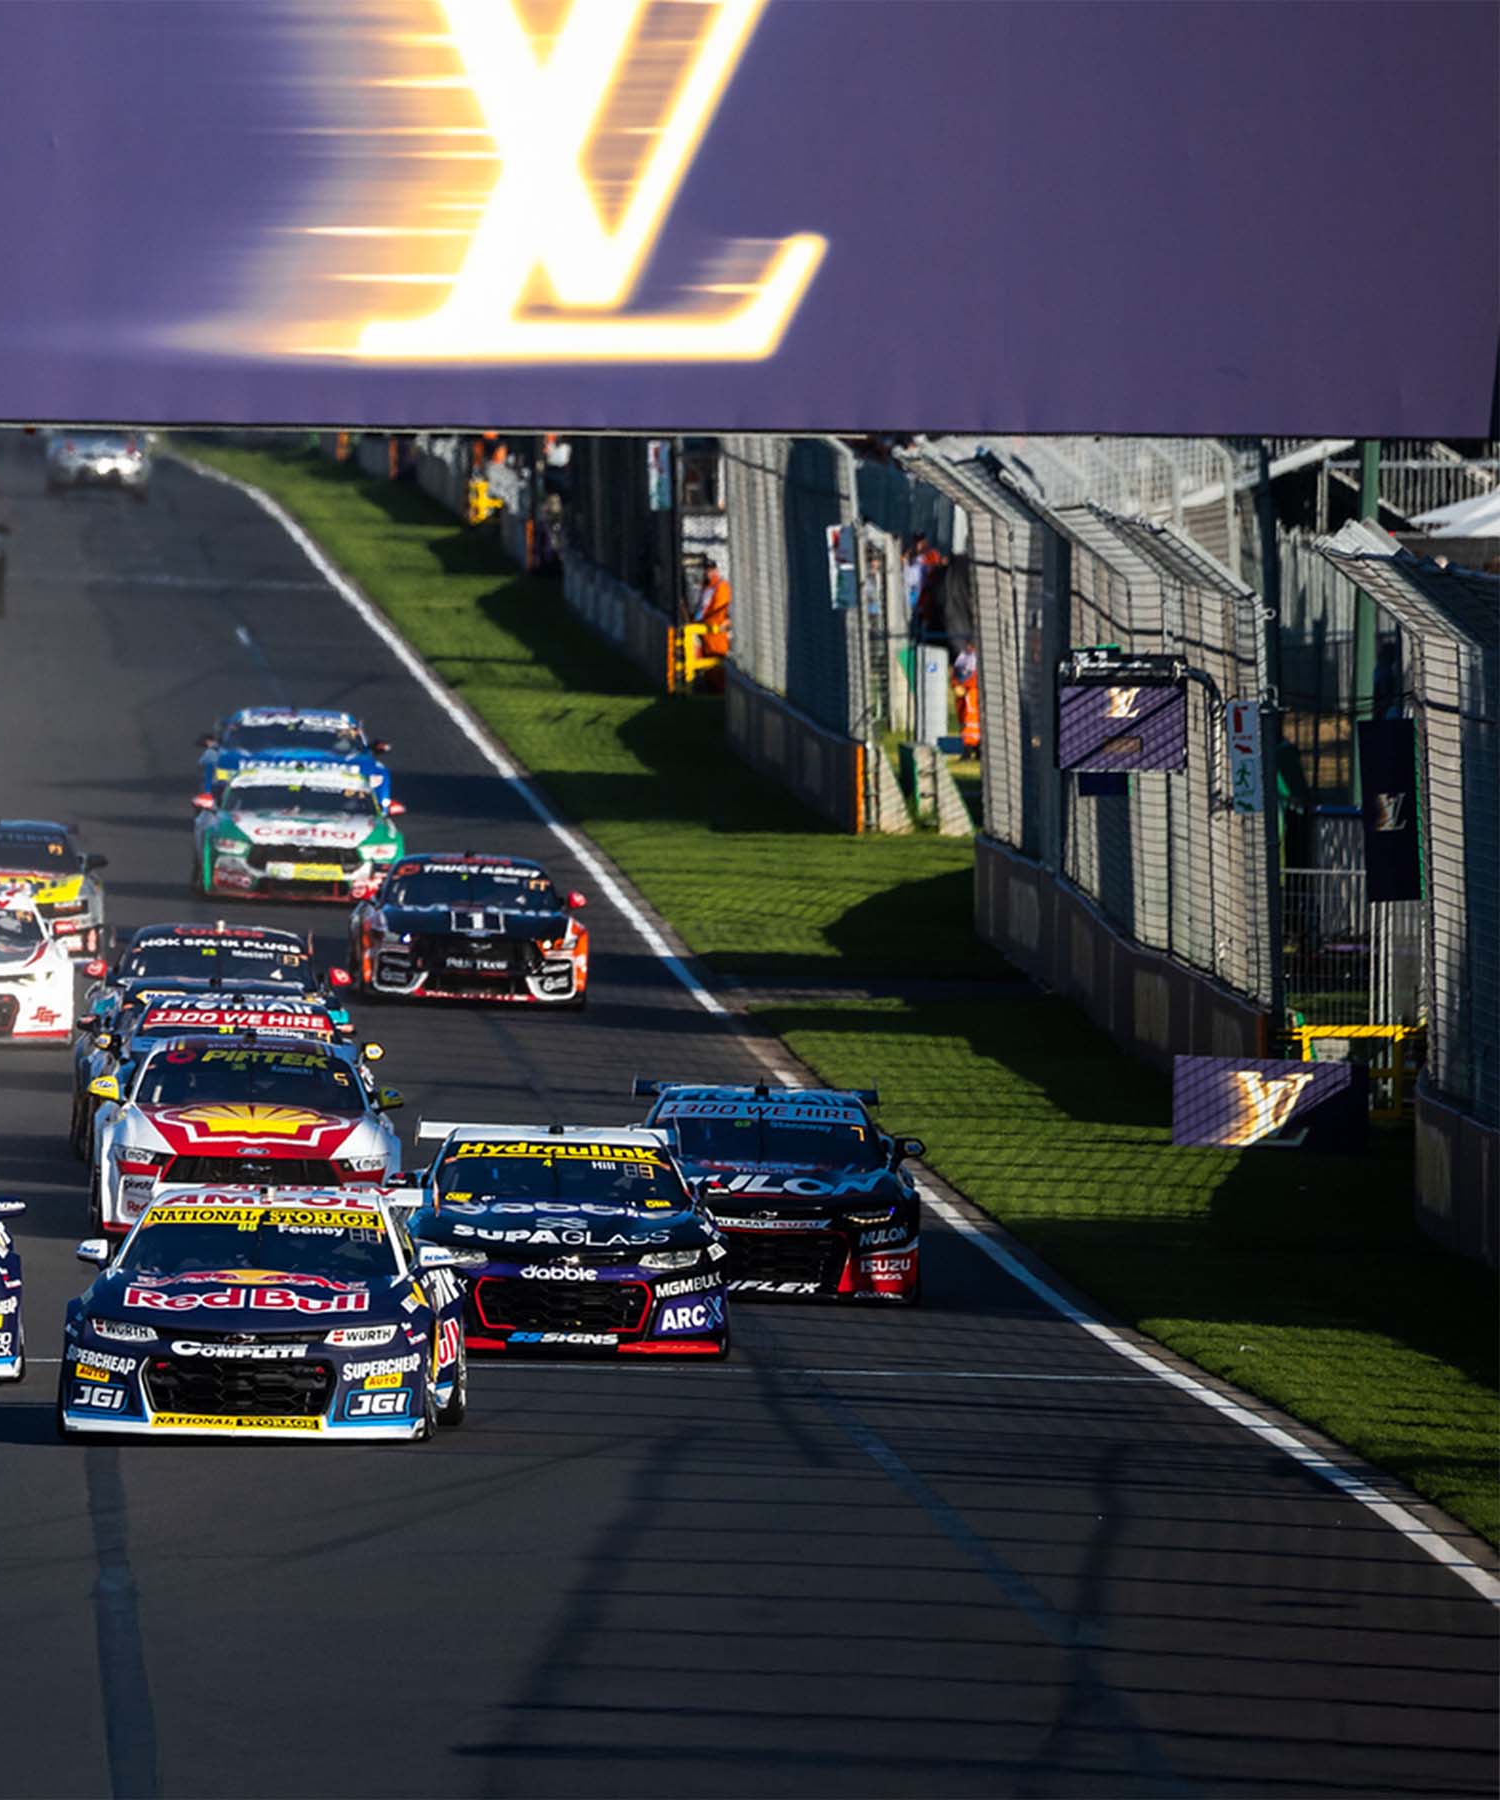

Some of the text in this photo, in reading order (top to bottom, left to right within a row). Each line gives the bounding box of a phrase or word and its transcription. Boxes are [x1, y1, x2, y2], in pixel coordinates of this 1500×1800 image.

[254, 826, 356, 840] Castrol
[467, 912, 484, 929] 1
[140, 938, 180, 947] NGK
[243, 940, 301, 953] PLUGS
[150, 1012, 325, 1028] 1300 WE HIRE
[202, 1050, 328, 1069] PIRTEK
[664, 1103, 858, 1120] 1300 WE HIRE
[457, 1141, 660, 1163] Hydraulink
[542, 1158, 553, 1168] 4
[591, 1160, 616, 1171] Hill
[150, 1209, 380, 1228] NATIONAL STORAGE
[716, 1218, 766, 1228] ALLARAT
[277, 1224, 345, 1238] Feeney
[452, 1223, 670, 1246] SUPAGLASS
[859, 1226, 908, 1247] NULON
[519, 1264, 599, 1281] dabble
[860, 1259, 911, 1273] ISUZU
[123, 1286, 370, 1314] Red Bull
[171, 1340, 308, 1359] COMPLETE
[66, 1343, 137, 1376] SUPERCHEAP
[342, 1353, 421, 1381] SUPERCHEAP
[79, 1366, 107, 1379] AUTO
[368, 1374, 398, 1386] AUTO
[73, 1386, 126, 1410] JGI
[349, 1393, 408, 1416] JGI
[154, 1415, 321, 1430] NATIONAL STORAGE
